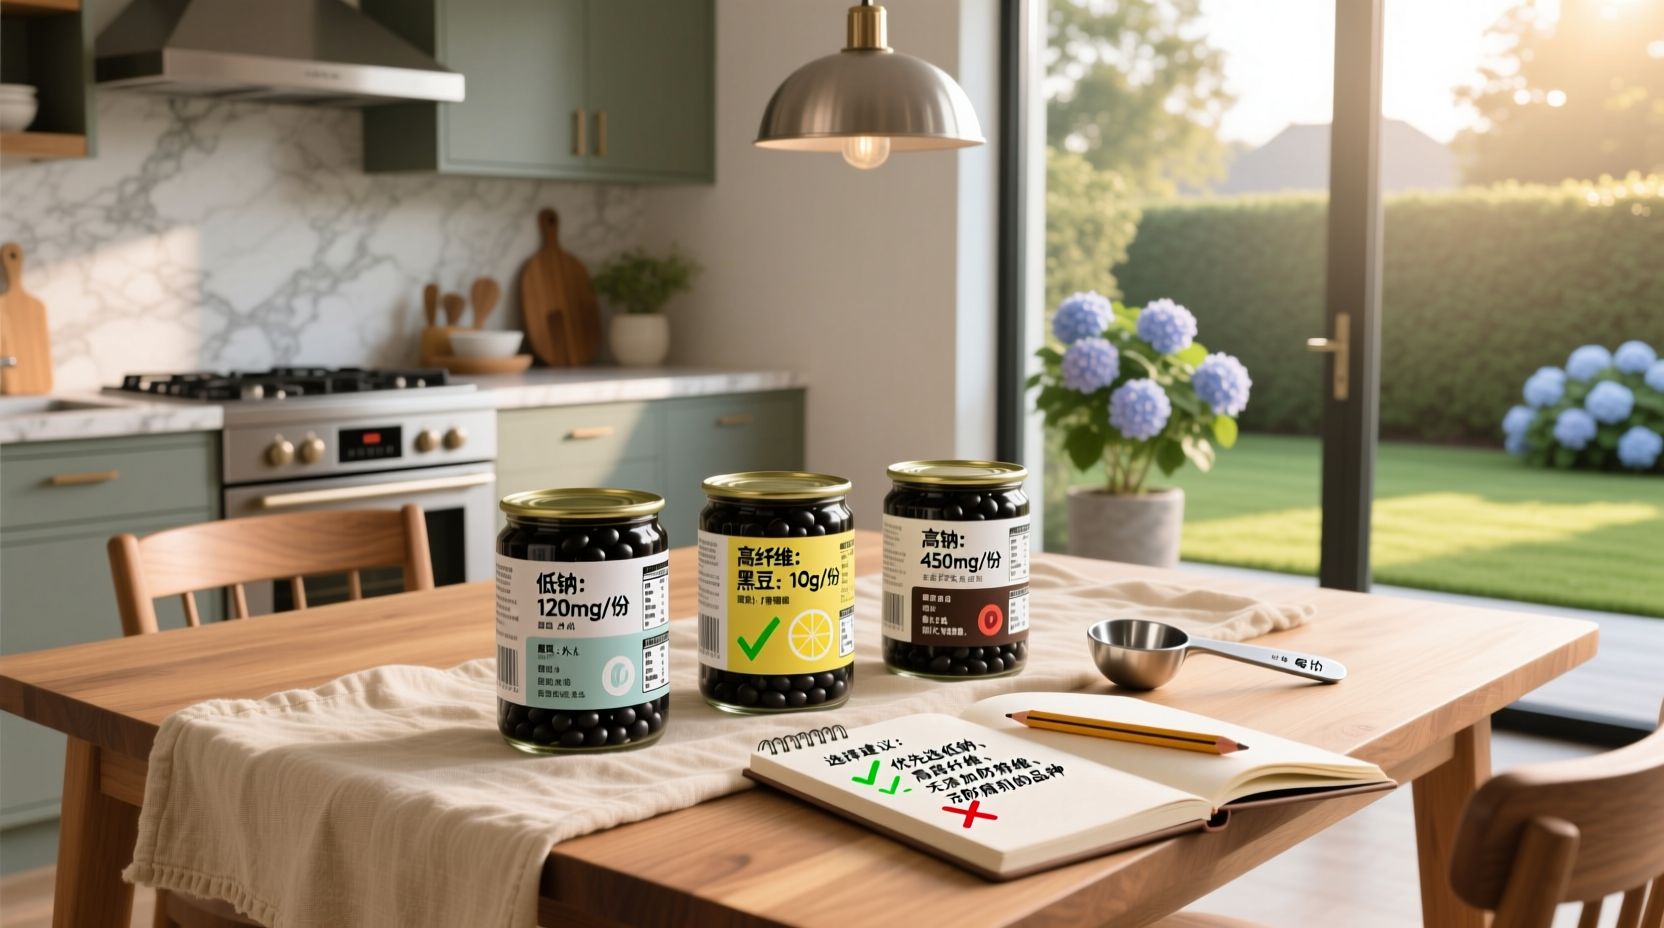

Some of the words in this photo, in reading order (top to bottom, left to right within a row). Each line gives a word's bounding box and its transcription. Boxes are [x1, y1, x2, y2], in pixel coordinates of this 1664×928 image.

[922, 528, 965, 549] 高钠：
[737, 545, 800, 567] 高纤维：
[920, 551, 1002, 573] 450mg/份
[536, 572, 585, 595] 低钠：
[537, 595, 630, 621] 120mg/份
